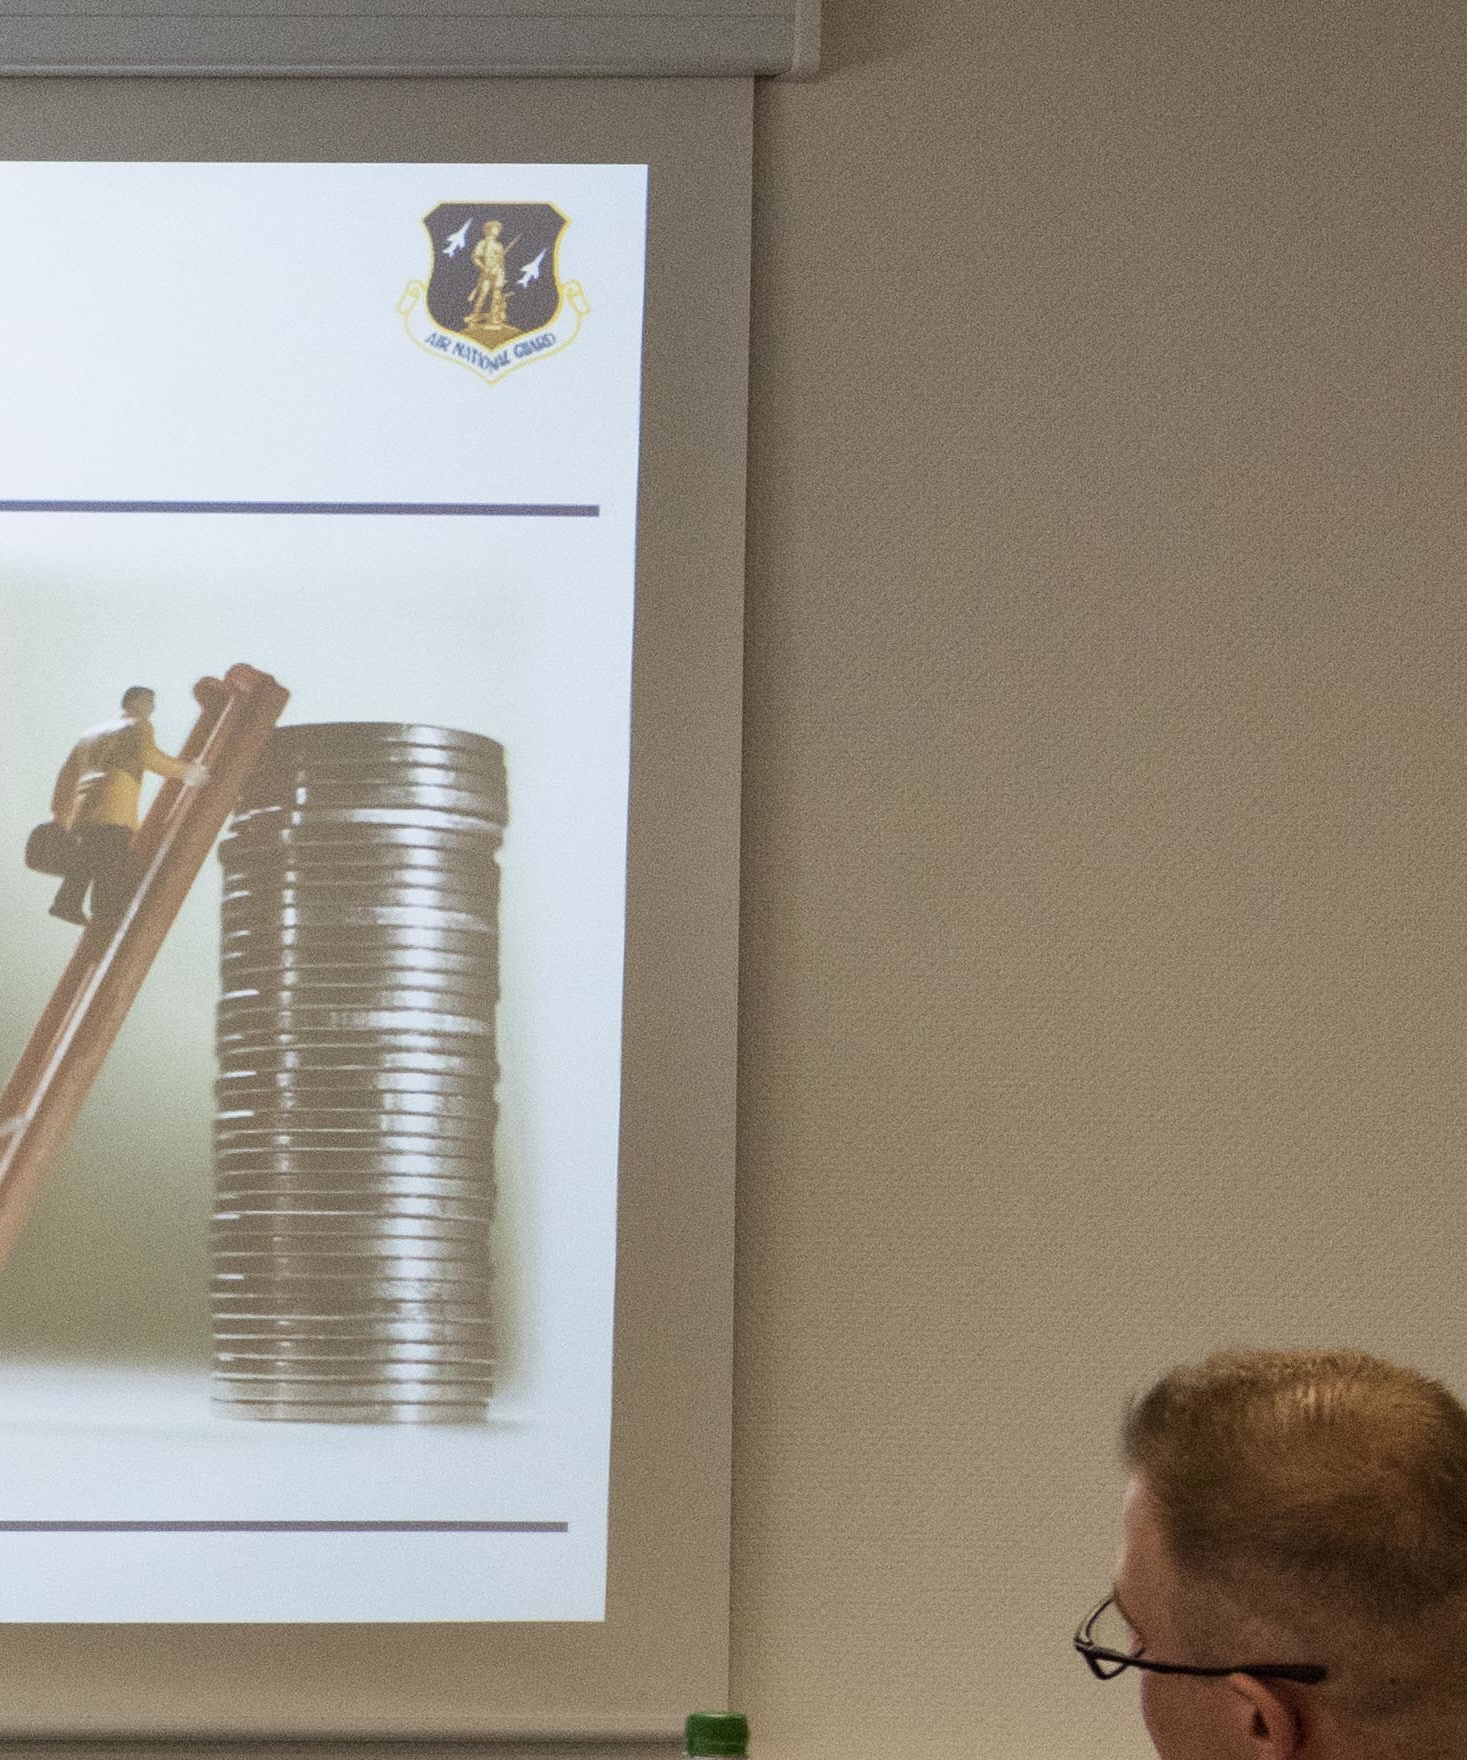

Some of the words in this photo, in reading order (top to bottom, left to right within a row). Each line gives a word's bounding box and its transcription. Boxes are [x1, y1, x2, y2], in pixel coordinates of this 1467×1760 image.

[425, 332, 451, 352] AIR
[452, 342, 512, 372] NATIONAL
[514, 332, 557, 358] GUARD
